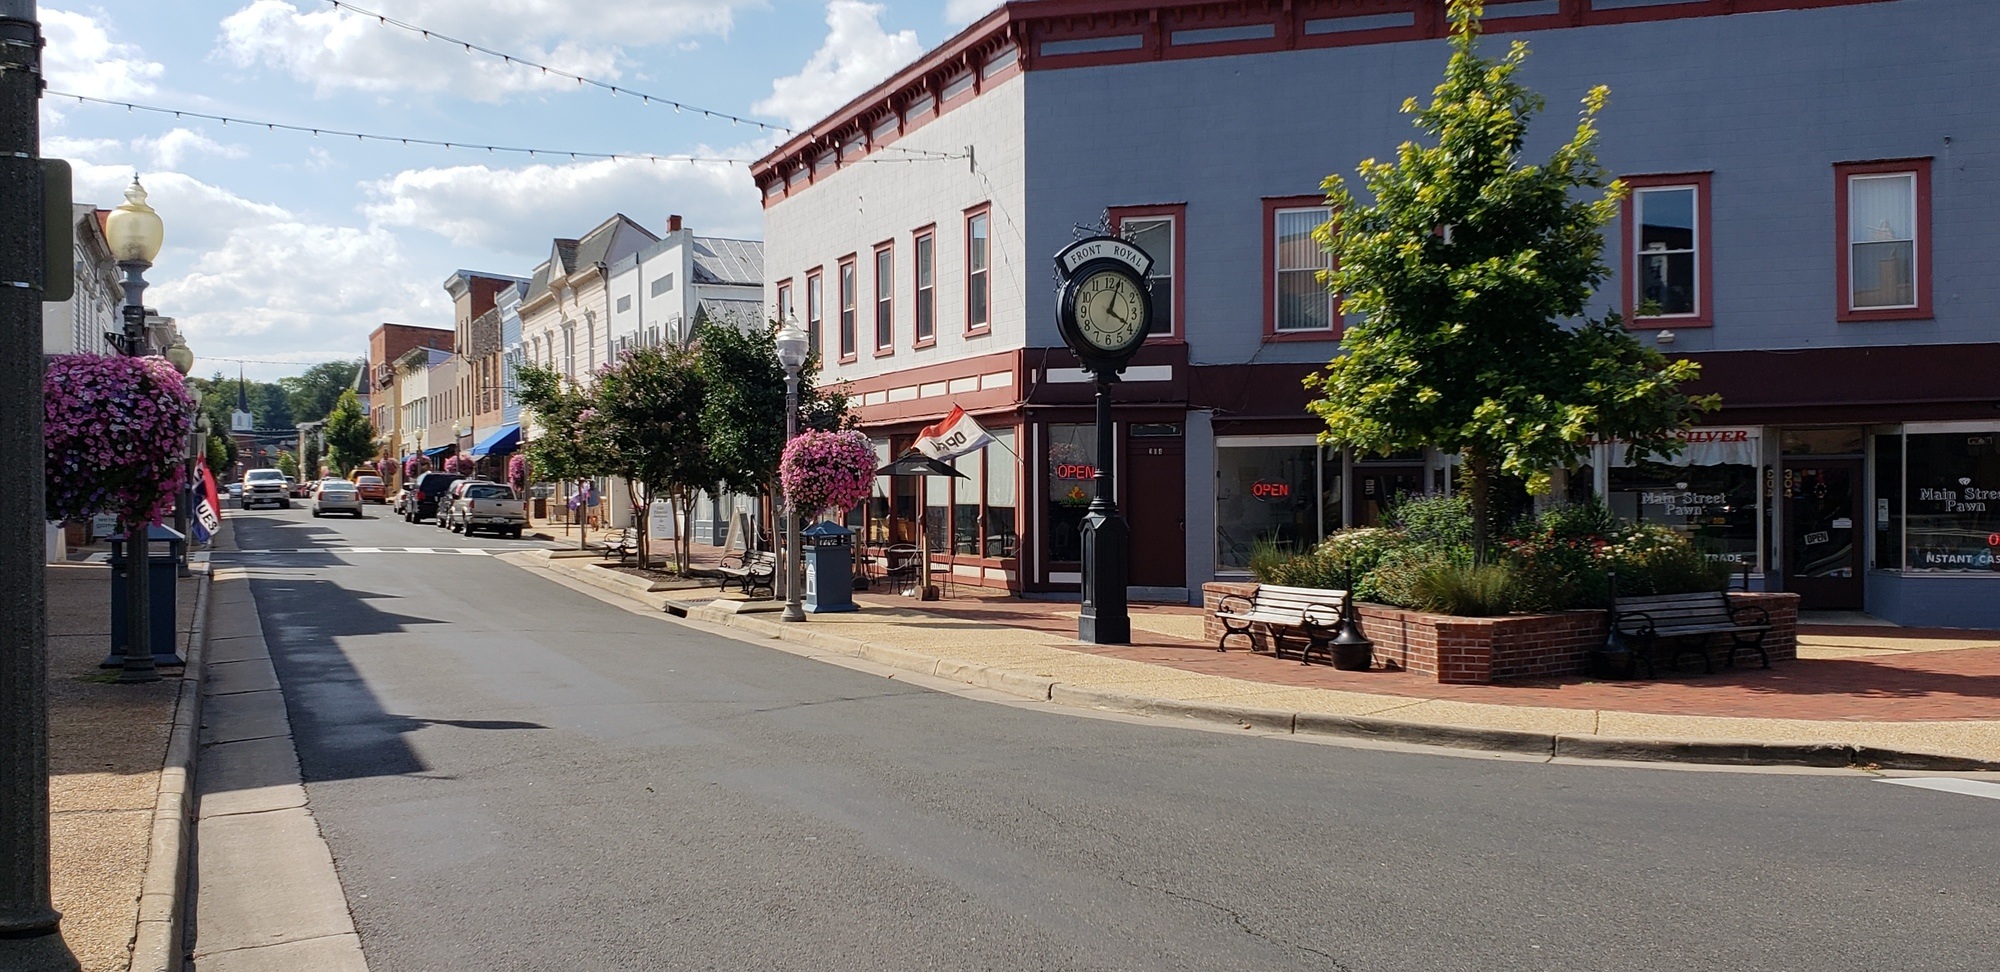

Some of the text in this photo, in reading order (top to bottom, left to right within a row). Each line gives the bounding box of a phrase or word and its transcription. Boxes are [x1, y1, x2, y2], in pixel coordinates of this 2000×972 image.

[1070, 244, 1142, 268] FRONT ROYAL
[1092, 280, 1099, 291] 11
[1105, 277, 1115, 289] 12
[1082, 292, 1091, 303] 10
[1129, 292, 1136, 304] 2
[1080, 306, 1087, 318] 9
[1131, 308, 1138, 320] 3
[1084, 320, 1091, 331] 8
[1126, 322, 1134, 335] 4
[1093, 331, 1100, 343] 7
[1105, 334, 1112, 345] 6
[1116, 332, 1124, 344] 5
[1058, 465, 1095, 479] OPEN
[1253, 483, 1288, 496] OPEN
[1920, 487, 1956, 500] Main
[1640, 492, 1726, 504] Main Street
[1664, 504, 1702, 515] Pawn
[1945, 500, 1986, 512] Pawn
[1806, 532, 1827, 543] OPEN
[1704, 554, 1742, 563] TRADE
